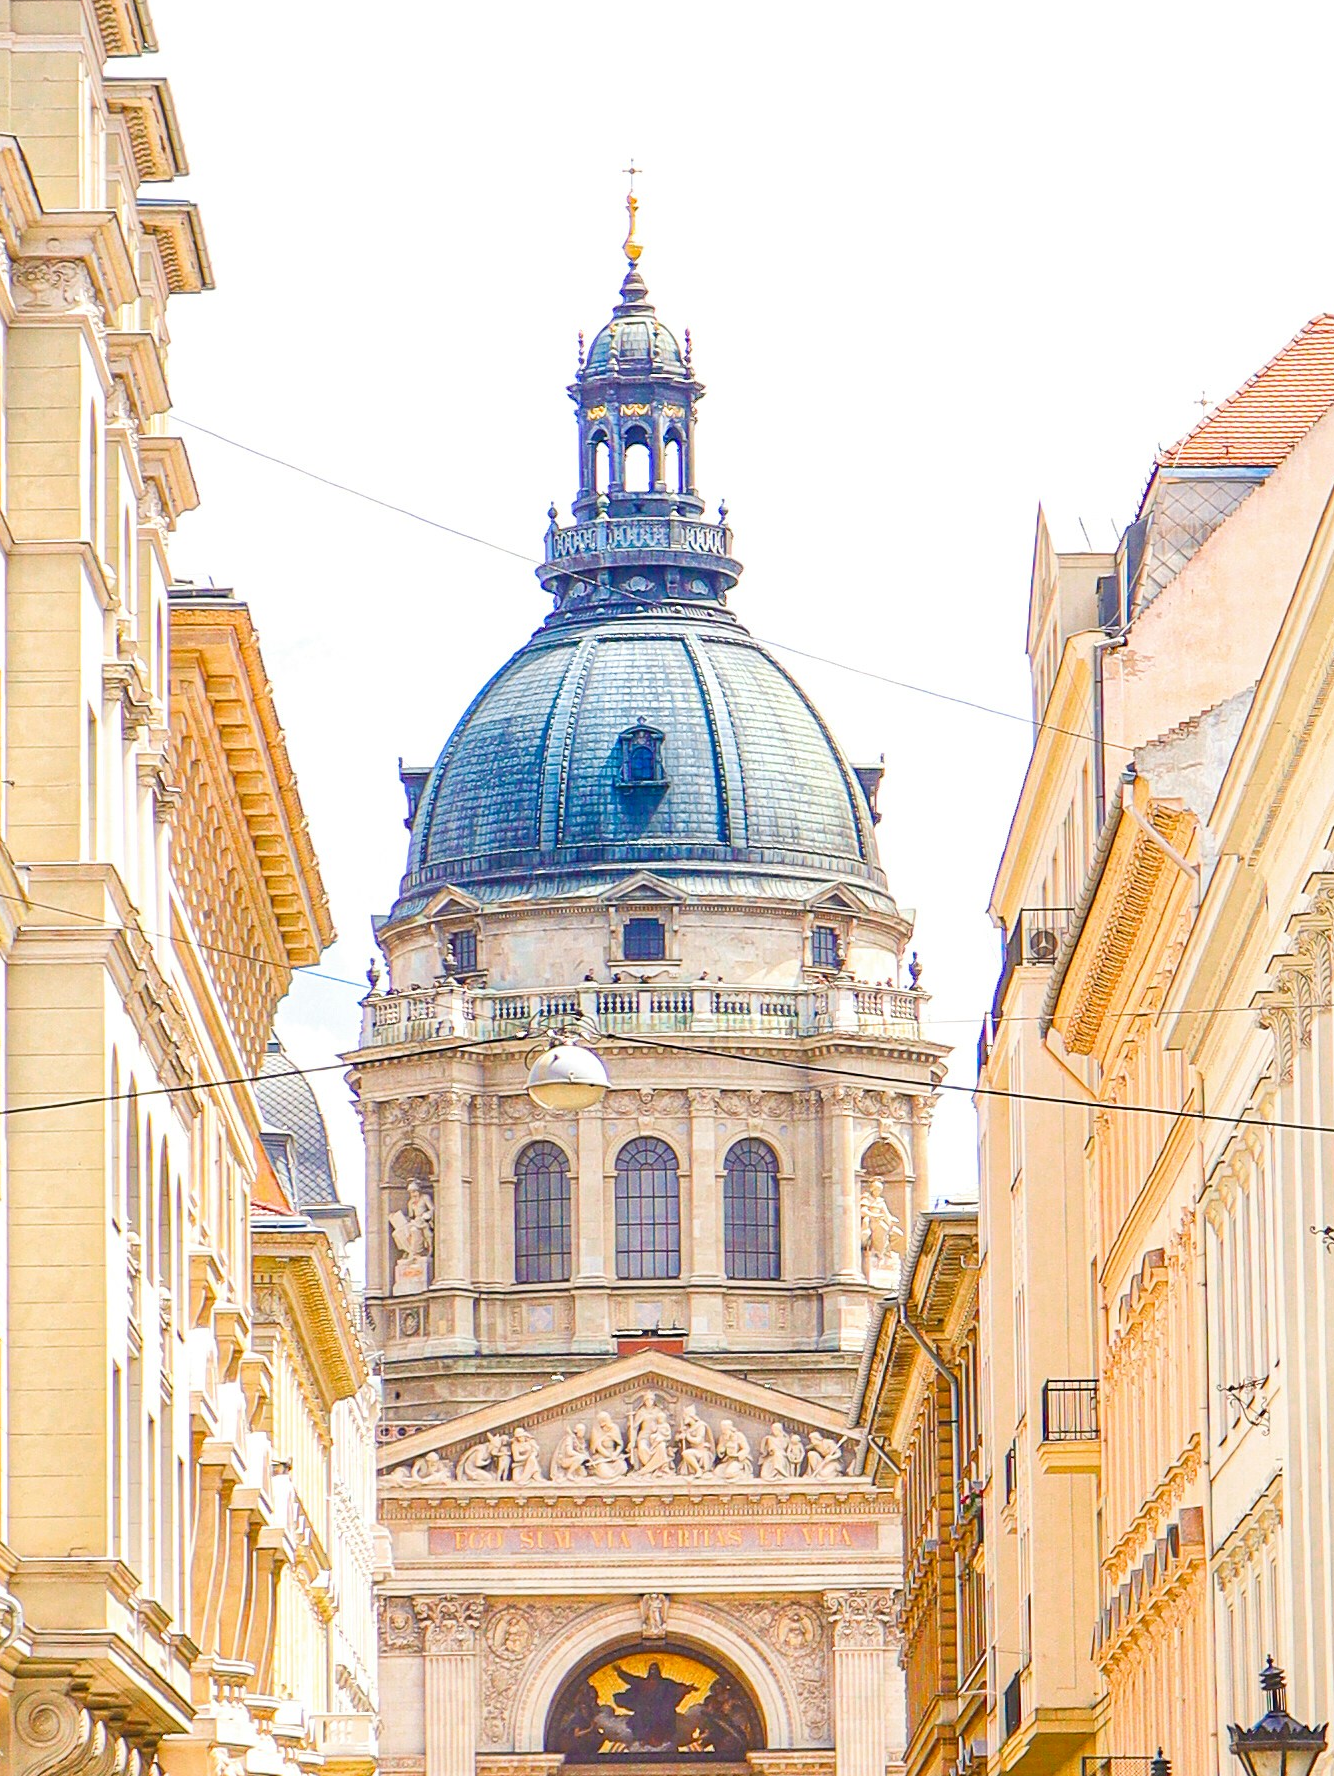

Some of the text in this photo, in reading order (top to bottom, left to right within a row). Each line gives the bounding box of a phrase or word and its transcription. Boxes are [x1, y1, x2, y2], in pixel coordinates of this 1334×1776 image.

[453, 1525, 853, 1550] EGO SUM VIA VERITAS ET VITA
